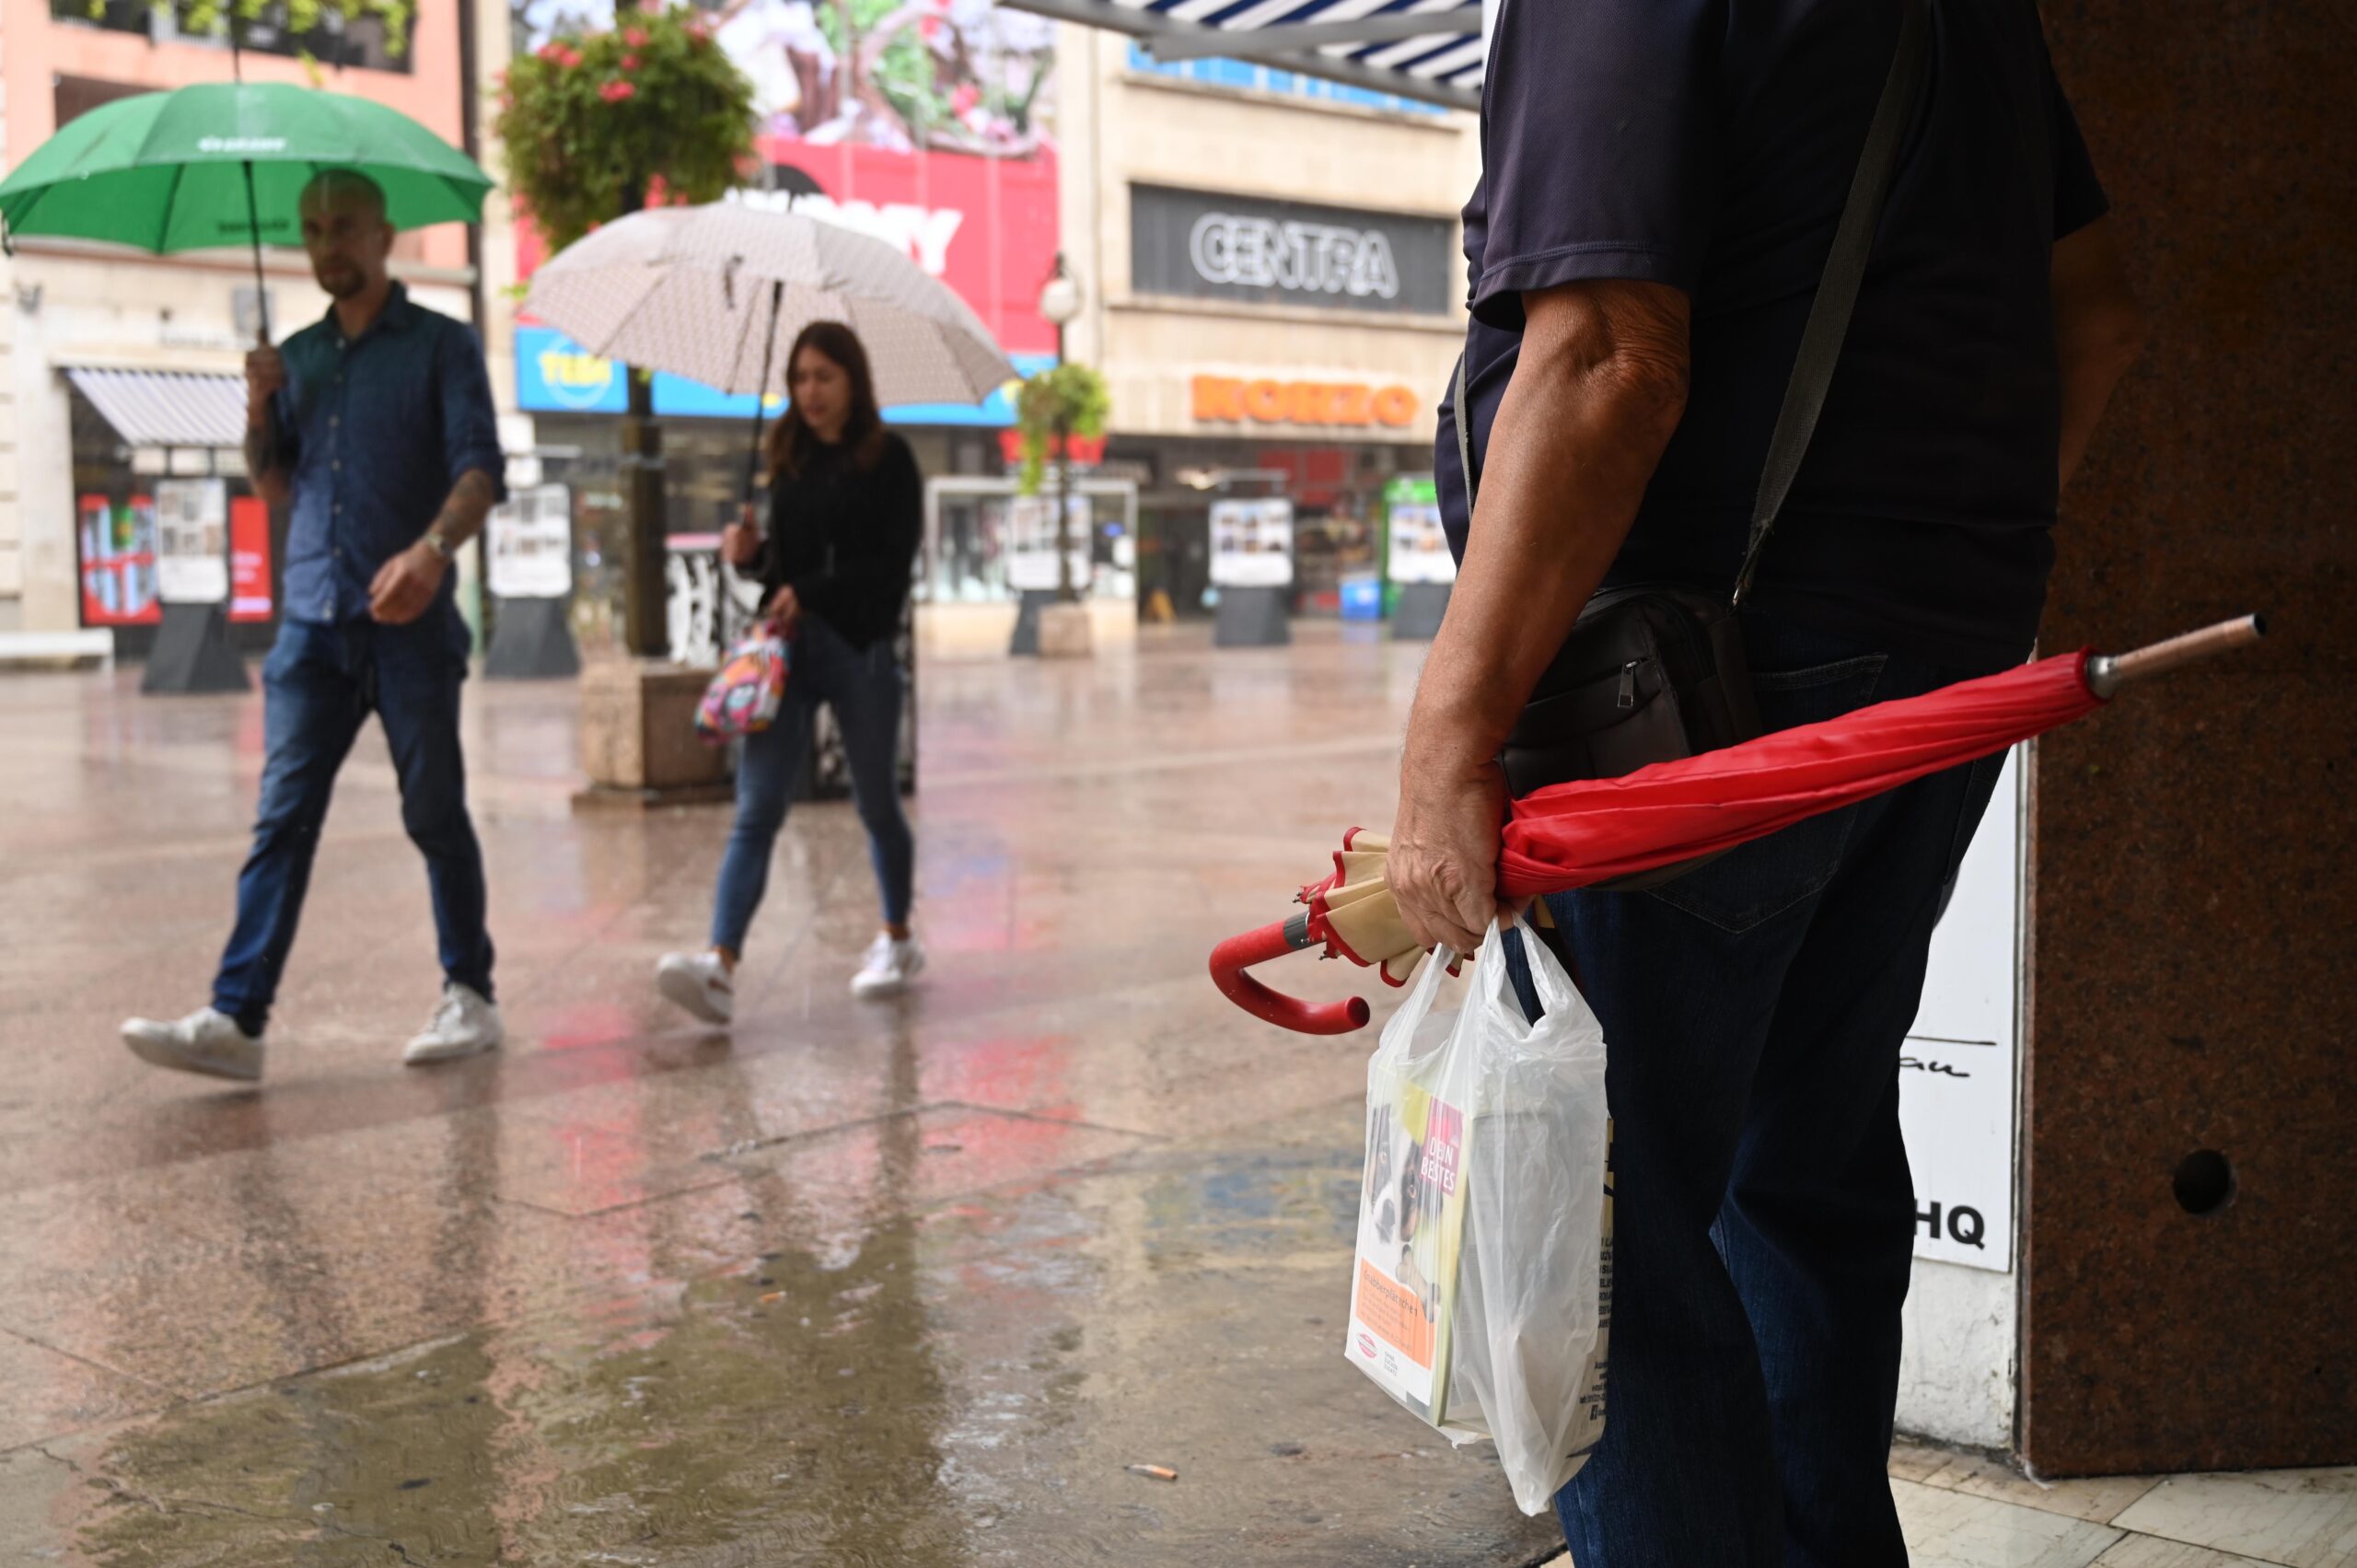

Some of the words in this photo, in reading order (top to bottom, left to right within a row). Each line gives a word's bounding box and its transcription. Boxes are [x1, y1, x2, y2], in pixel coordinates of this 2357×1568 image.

[1190, 213, 1399, 299] CENTRA
[1429, 1136, 1455, 1167] DEIN
[1421, 1156, 1456, 1192] BESTES
